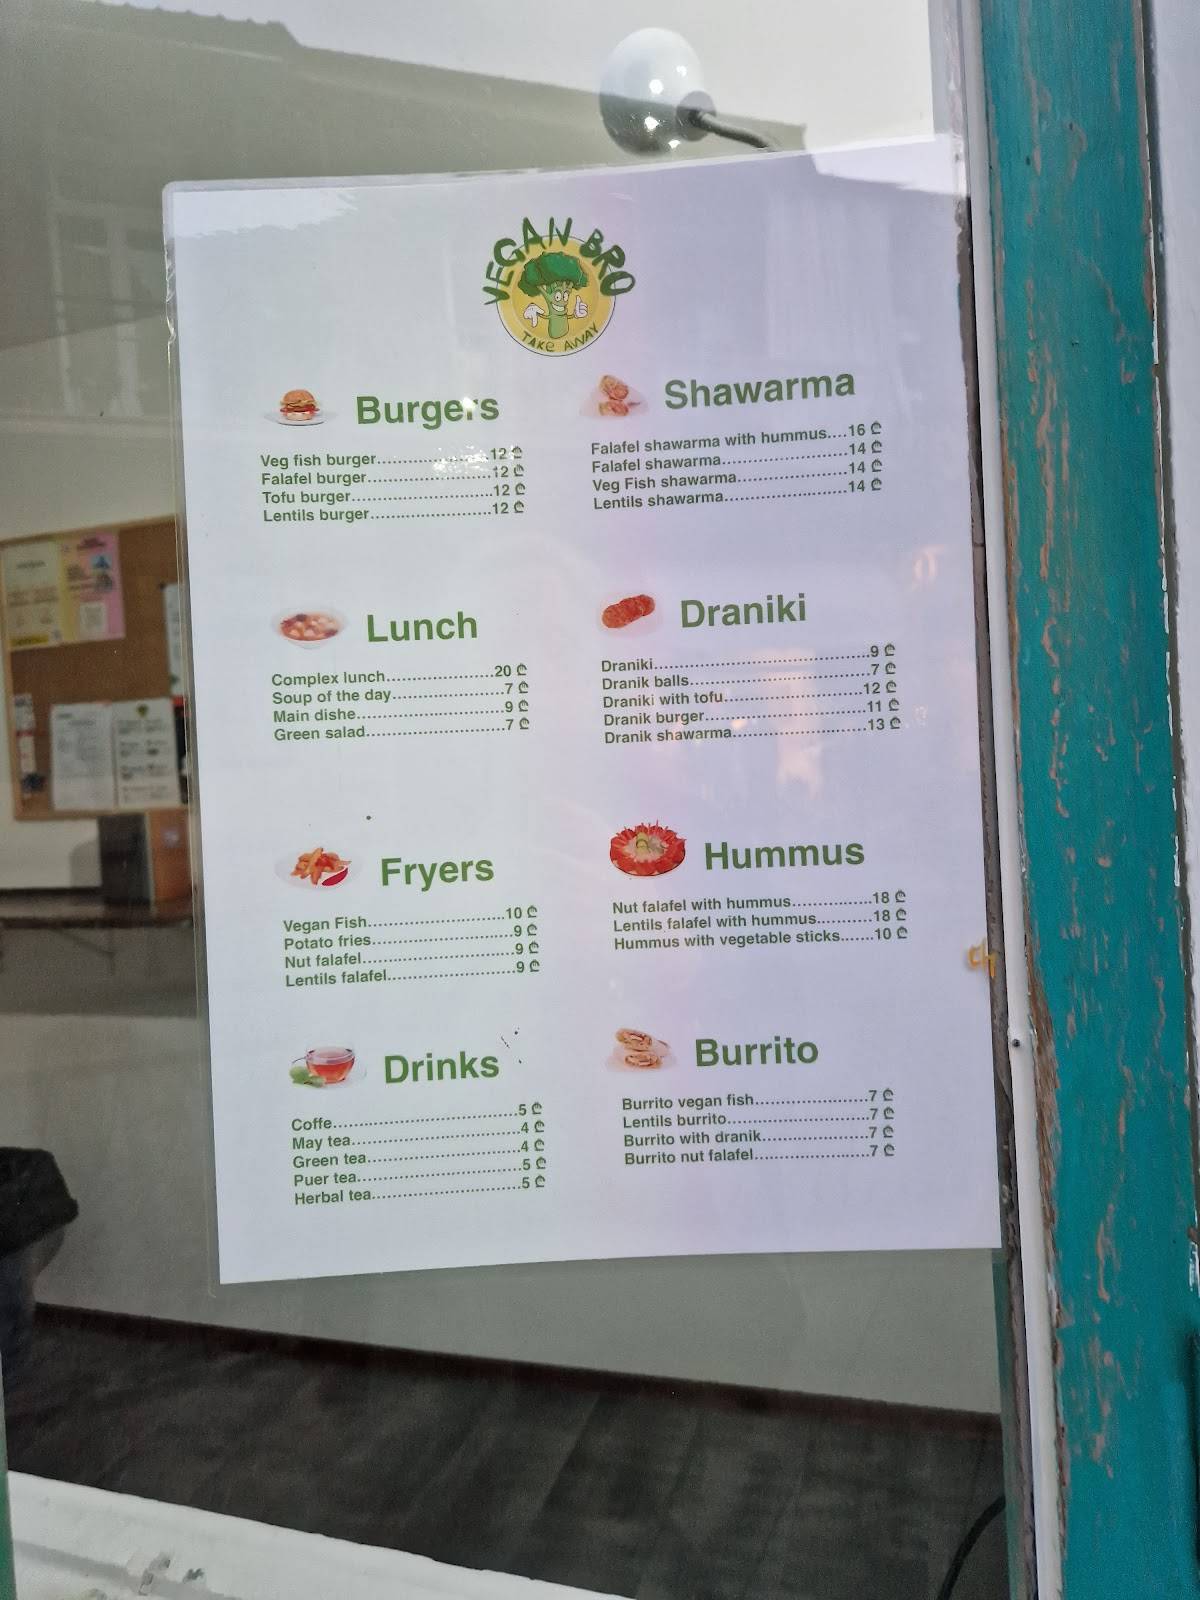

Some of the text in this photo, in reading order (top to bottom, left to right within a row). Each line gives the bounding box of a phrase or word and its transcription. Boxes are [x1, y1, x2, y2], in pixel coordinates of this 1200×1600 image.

[483, 216, 636, 305] VEGAN BRO
[564, 323, 599, 351] AWAY
[665, 374, 855, 409] Shawarma
[357, 394, 499, 430] Burgers
[591, 440, 639, 455] Falafel
[644, 437, 720, 452] shawarma
[725, 433, 756, 446] with
[761, 430, 827, 444] hummus
[849, 424, 866, 436] 16
[260, 455, 288, 470] Veg
[293, 454, 321, 466] fish
[326, 454, 376, 468] burger
[592, 458, 640, 473] Falafel
[645, 456, 721, 470] shawarma
[849, 442, 866, 455] 14
[262, 472, 311, 485] Falafel
[317, 472, 366, 486] burger
[492, 465, 509, 478] 12
[592, 479, 619, 493] Veg
[625, 477, 655, 490] Fish
[661, 474, 736, 488] shawarma
[849, 461, 866, 474] 14
[262, 491, 295, 504] Tofu
[301, 491, 351, 505] burger
[493, 484, 510, 496] 12
[594, 496, 643, 509] Lentils
[648, 493, 723, 506] shawarma
[848, 480, 865, 493] 14
[264, 509, 314, 522] Lentils
[320, 509, 369, 523] burger
[493, 502, 509, 514] 12
[681, 593, 806, 628] Draniki
[367, 611, 477, 642] Lunch
[602, 658, 653, 672] Draniki
[870, 645, 879, 657] 9
[272, 672, 339, 688] Complex
[344, 670, 385, 683] lunch
[495, 665, 511, 678] 20
[602, 676, 649, 690] Dranik
[654, 674, 689, 687] balls
[871, 664, 879, 675] 7
[272, 692, 312, 706] Soup
[317, 690, 332, 702] of
[336, 690, 360, 702] the
[364, 688, 391, 703] day
[505, 683, 513, 694] 7
[603, 694, 654, 708] Draniki
[659, 693, 689, 705] with
[694, 691, 723, 703] tofu
[864, 682, 880, 694] 12
[274, 710, 309, 723] Main
[314, 708, 356, 721] dishe
[505, 701, 513, 713] 9
[604, 712, 651, 726] Dranik
[656, 712, 704, 725] burger
[867, 700, 881, 712] 11
[274, 728, 320, 741] Green
[325, 725, 365, 739] salad
[506, 719, 514, 730] 7
[605, 730, 652, 744] Dranik
[657, 729, 732, 741] shawarma
[868, 718, 885, 730] 13
[705, 842, 864, 870] Hummus
[381, 857, 494, 892] Fryers
[613, 902, 638, 914] Nut
[642, 899, 686, 912] falafel
[691, 898, 721, 911] with
[727, 897, 791, 909] hummus
[873, 892, 890, 904] 18
[283, 920, 330, 934] Vegan
[335, 916, 367, 929] Fish
[506, 907, 523, 919] 10
[614, 918, 662, 932] Lentils
[667, 916, 711, 929] falafel
[716, 915, 746, 927] with
[752, 914, 817, 926] hummus
[874, 909, 890, 922] 18
[284, 937, 333, 950] Potato
[338, 934, 371, 947] fries
[514, 925, 522, 937] 9
[615, 937, 679, 950] Hummus
[684, 934, 714, 947] with
[720, 931, 791, 948] vegetable
[796, 930, 840, 943] sticks
[875, 928, 892, 940] 10
[285, 956, 311, 968] Nut
[315, 952, 361, 967] falafel
[515, 943, 523, 955] 9
[286, 972, 336, 987] Lentils
[341, 969, 386, 983] falafel
[516, 961, 525, 973] 9
[696, 1036, 818, 1067] Burrito
[385, 1051, 499, 1084] Drinks
[622, 1097, 673, 1110] Burrito
[678, 1097, 722, 1110] vegan
[726, 1093, 754, 1106] fish
[869, 1090, 877, 1102] 7
[291, 1117, 332, 1131] Coffe
[519, 1104, 527, 1116] 5
[623, 1115, 672, 1128] Lentils
[677, 1113, 726, 1126] burrito
[869, 1108, 878, 1120] 7
[293, 1137, 323, 1151] May
[327, 1136, 350, 1147] tea
[521, 1122, 529, 1133] 4
[624, 1133, 675, 1147] Burrito
[680, 1132, 709, 1144] with
[715, 1130, 761, 1143] dranik
[869, 1126, 877, 1139] 7
[293, 1156, 338, 1168] Green
[344, 1153, 366, 1164] tea
[521, 1140, 529, 1152] 4
[625, 1152, 676, 1165] Burrito
[681, 1150, 704, 1163] nut
[708, 1148, 753, 1162] falafel
[870, 1145, 878, 1157] 7
[294, 1174, 329, 1187] Puer
[333, 1172, 356, 1183] tea
[522, 1158, 530, 1171] 5
[295, 1190, 343, 1205] Herbal
[349, 1190, 371, 1201] tea
[522, 1177, 530, 1189] 5
